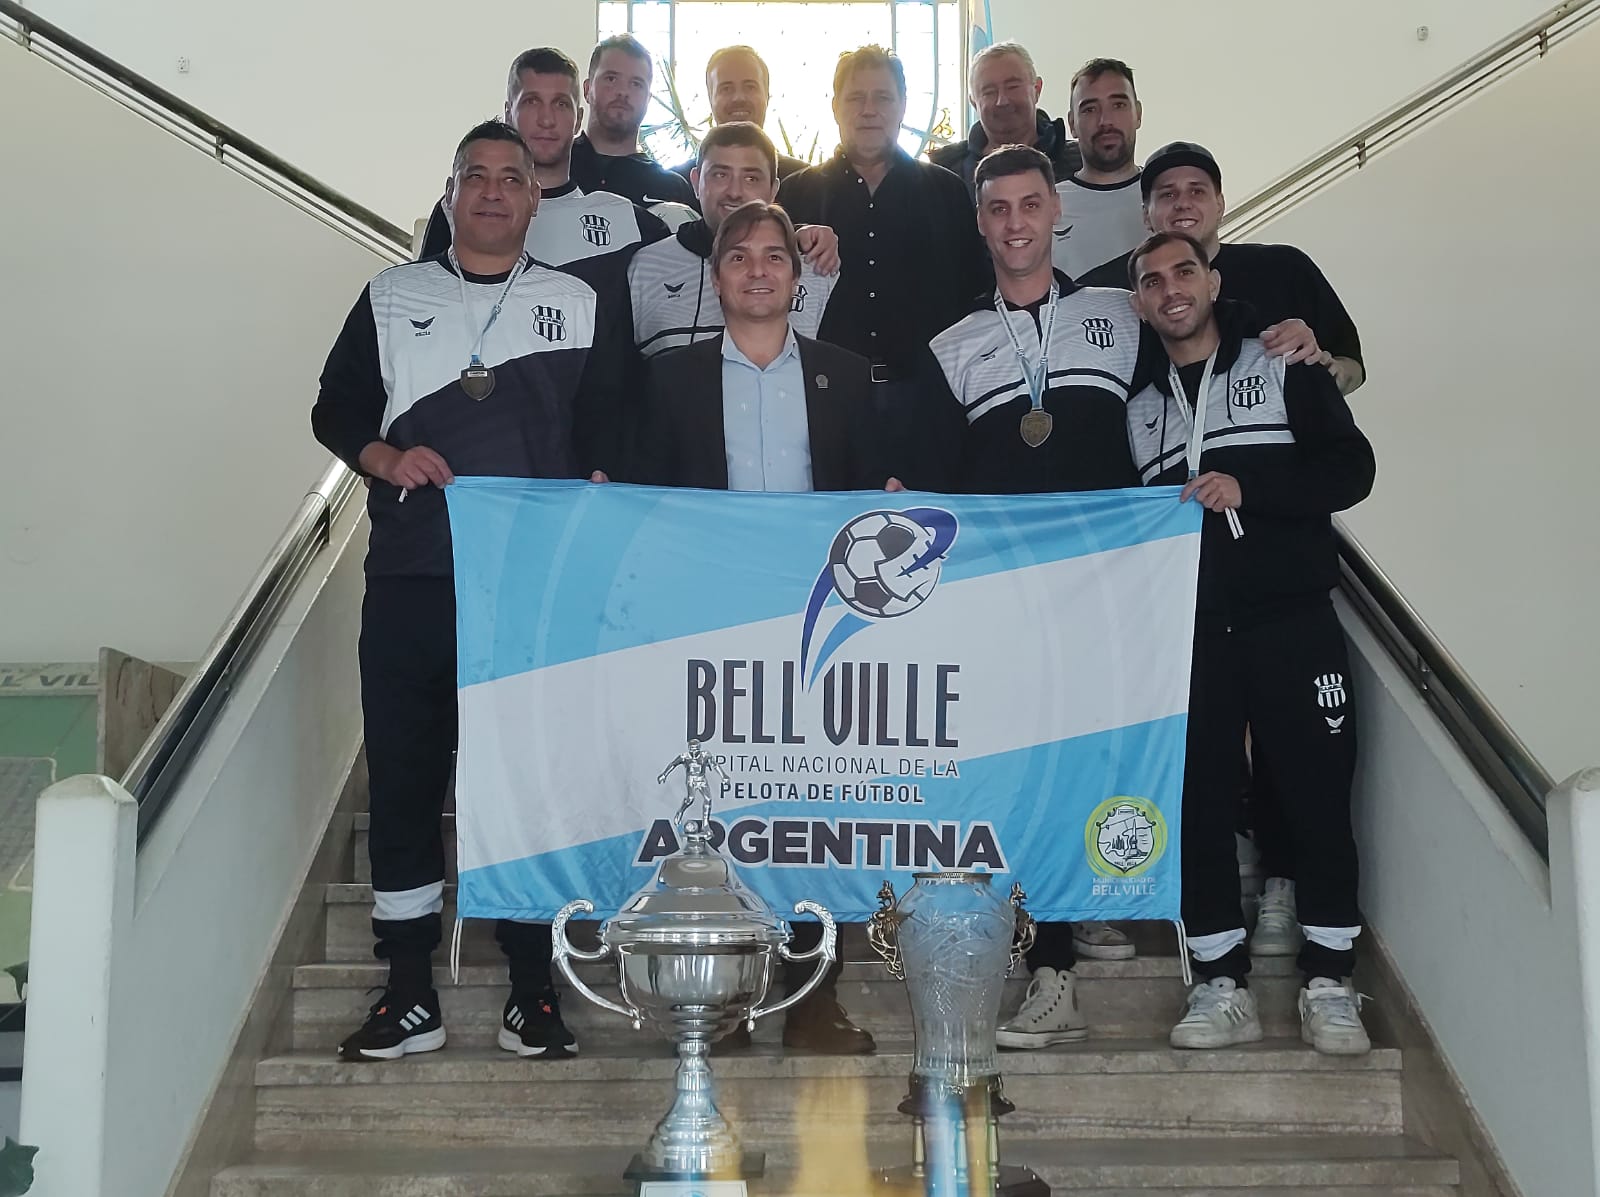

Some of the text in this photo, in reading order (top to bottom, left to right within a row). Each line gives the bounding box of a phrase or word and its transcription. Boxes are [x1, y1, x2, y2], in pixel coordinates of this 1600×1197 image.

[687, 659, 961, 748] BELL VILLE
[705, 755, 958, 777] PITAL NACIONAL DE LA
[719, 780, 924, 803] PELOTA DE FÚTBOL
[1092, 884, 1157, 896] BELL VILLE
